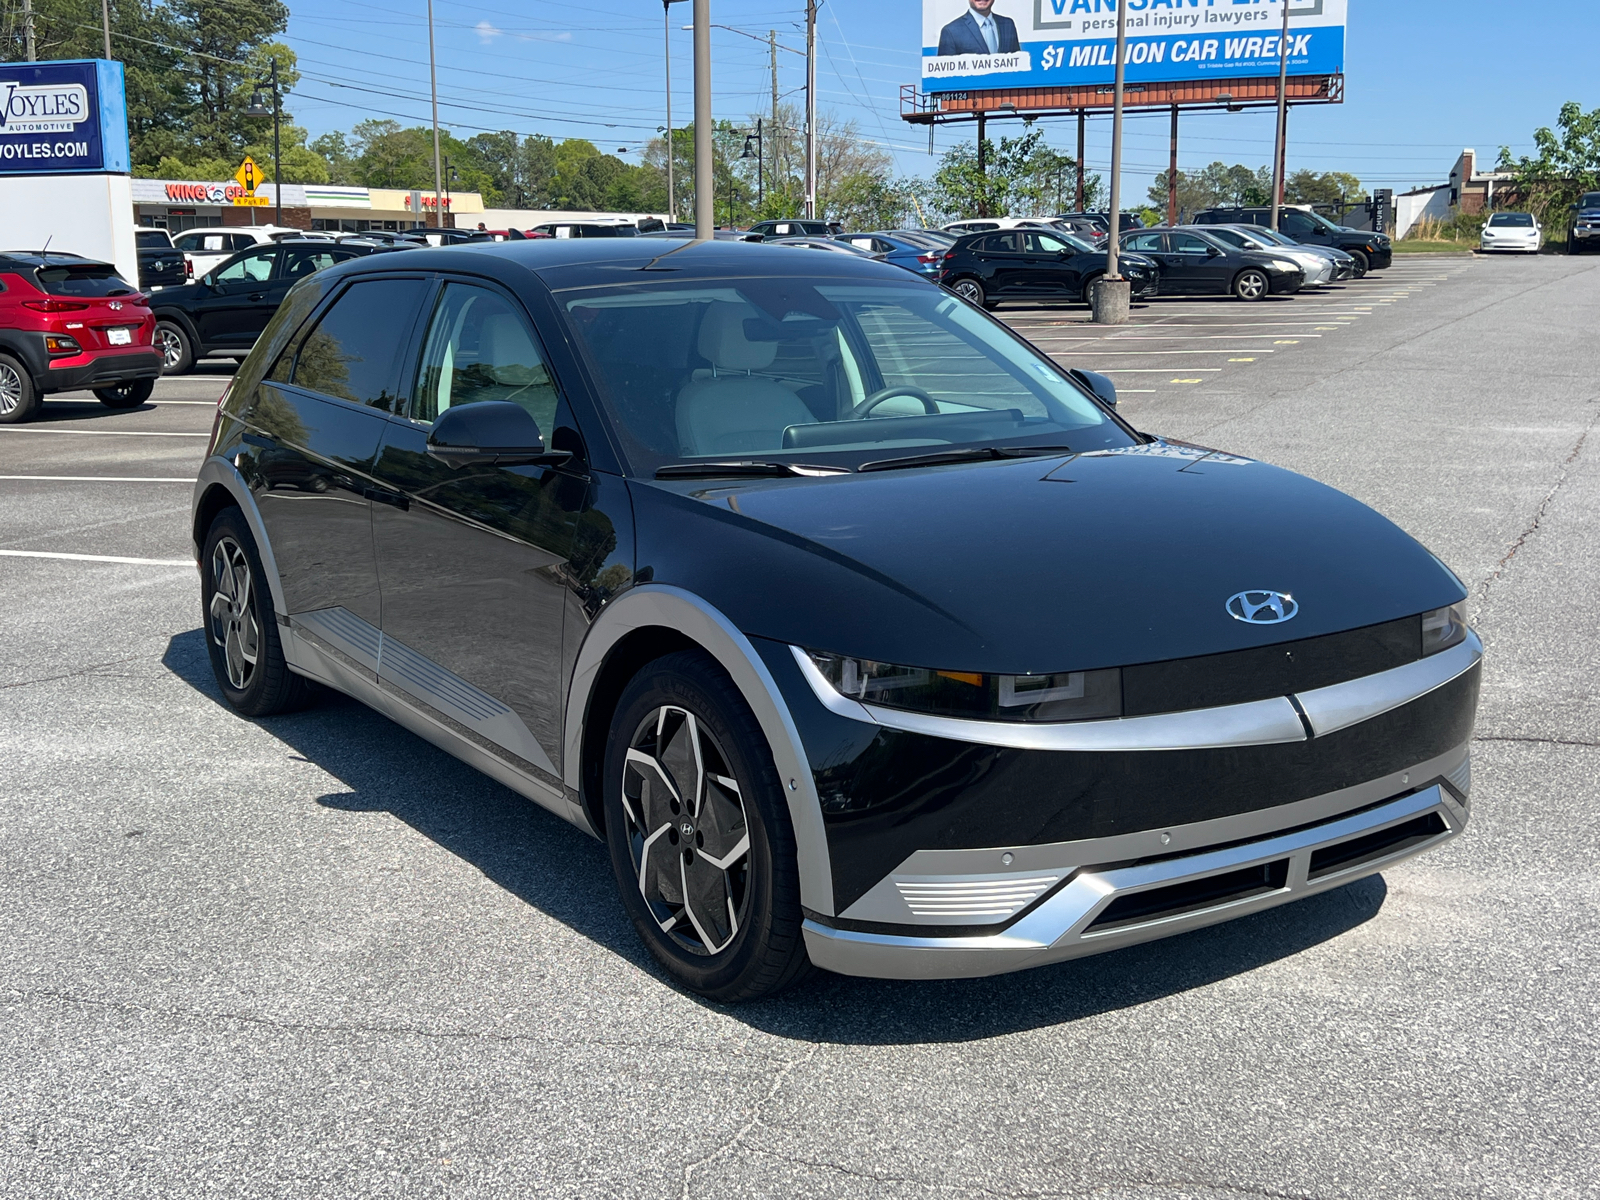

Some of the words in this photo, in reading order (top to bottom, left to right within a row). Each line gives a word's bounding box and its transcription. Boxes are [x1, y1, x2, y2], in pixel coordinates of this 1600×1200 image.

[1082, 13, 1148, 33] persnal
[1153, 12, 1199, 29] injury
[1204, 10, 1268, 25] lawyers
[1041, 45, 1065, 70] $1
[1171, 39, 1219, 62] CAR
[1224, 34, 1312, 59] WRECK
[928, 61, 956, 72] DAVID
[957, 61, 969, 70] M.
[971, 59, 991, 69] VAN
[993, 57, 1019, 68] SANT
[9, 122, 72, 132] AUTOMOTIVE
[165, 183, 207, 200] WING
